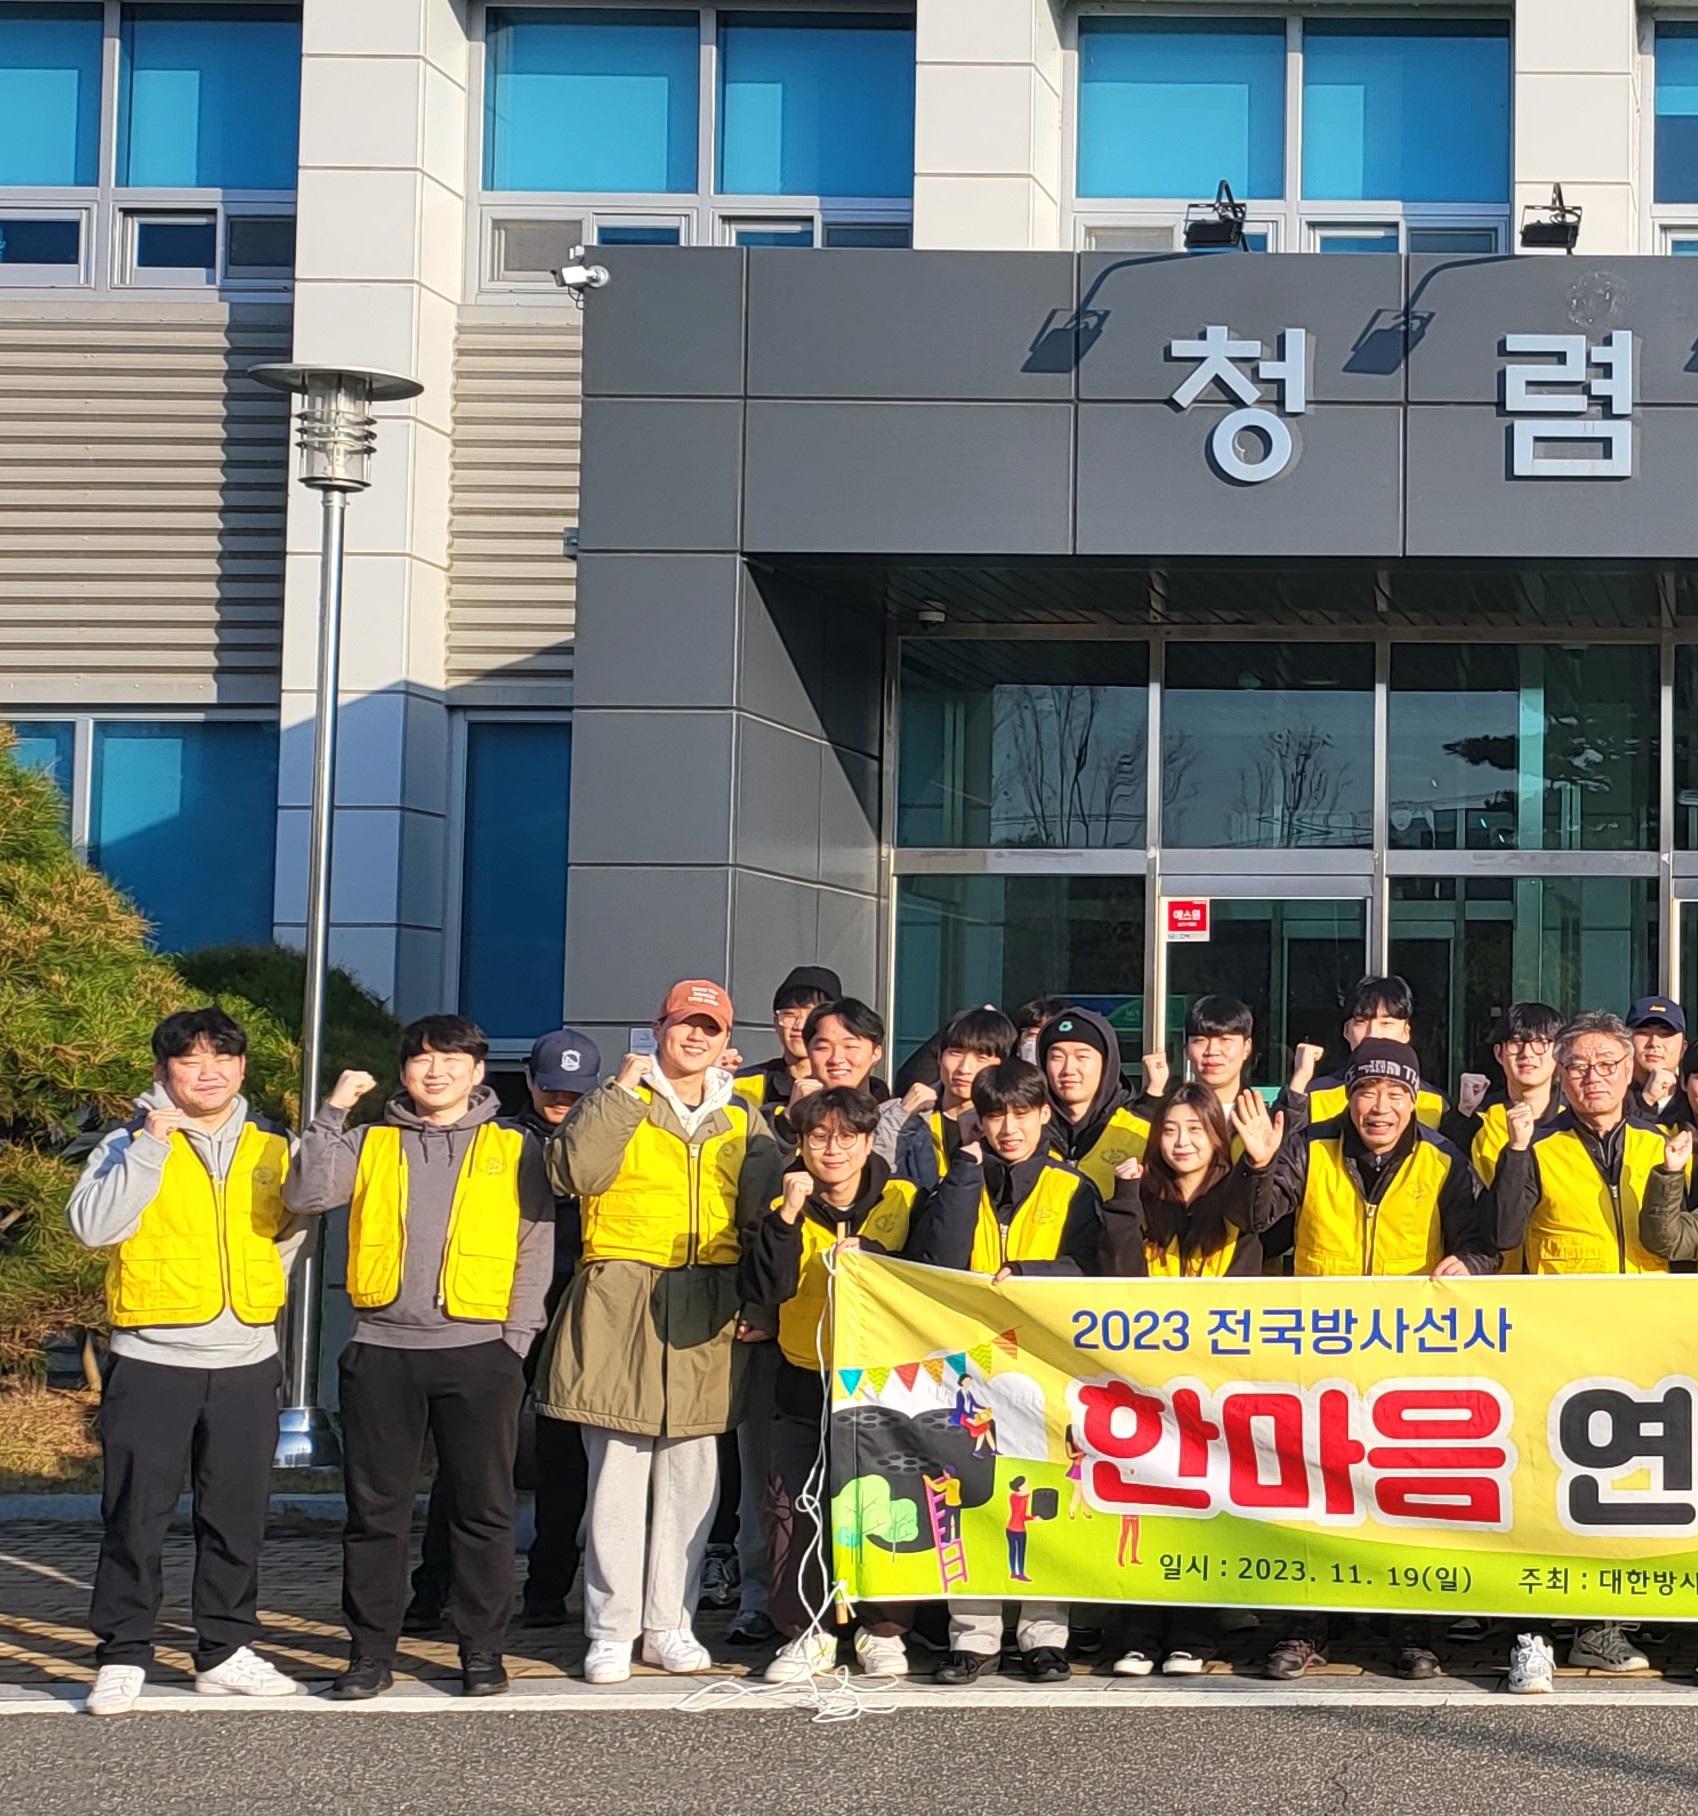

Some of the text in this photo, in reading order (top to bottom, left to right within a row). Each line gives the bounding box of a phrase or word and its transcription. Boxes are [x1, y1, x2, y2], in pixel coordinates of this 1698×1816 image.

[1071, 1307, 1513, 1355] 2023 전국방사선사
[1077, 1380, 1507, 1524] 한마음
[1159, 1553, 1209, 1581] 일시
[1237, 1557, 1317, 1582] 2023.
[1331, 1562, 1373, 1585] 11.
[1387, 1565, 1473, 1593] 19(일)
[1518, 1566, 1570, 1595] 주최
